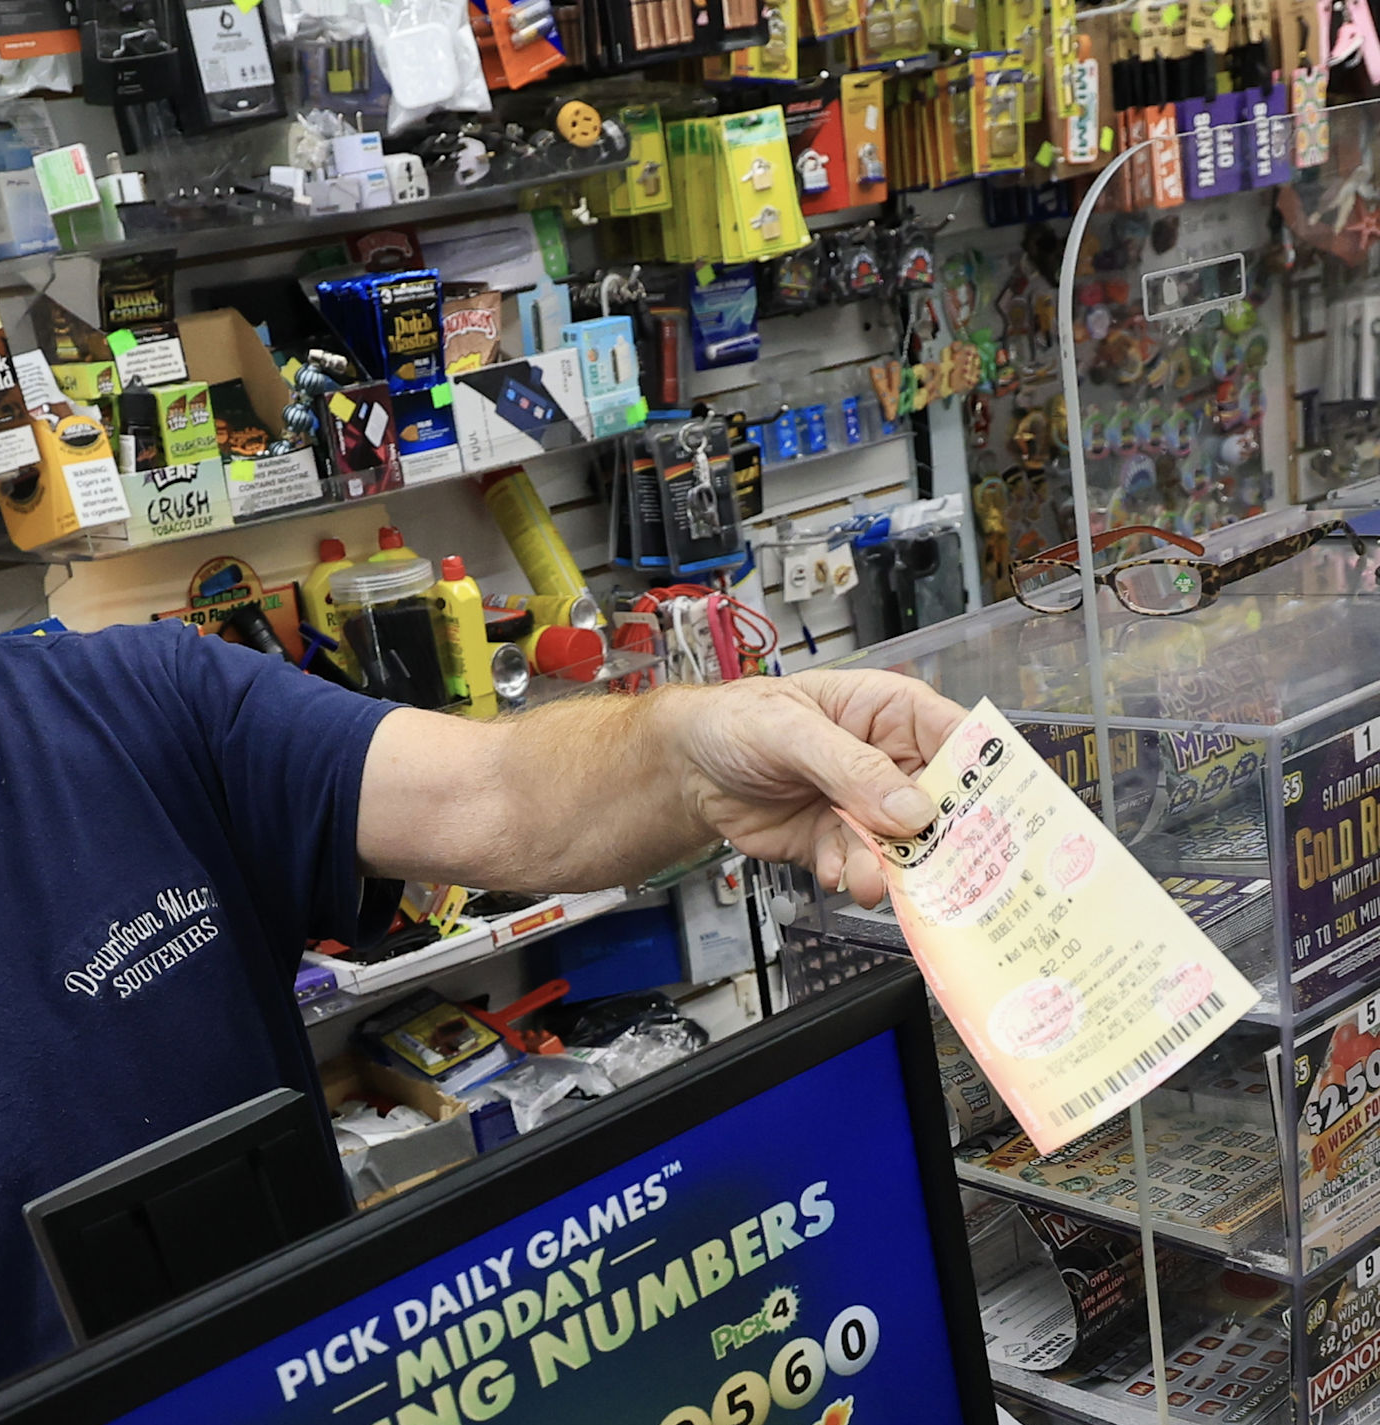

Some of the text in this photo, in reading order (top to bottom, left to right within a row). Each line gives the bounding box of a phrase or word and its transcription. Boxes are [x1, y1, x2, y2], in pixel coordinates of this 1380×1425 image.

[1194, 112, 1215, 188] HANDS
[1217, 119, 1234, 168] OFF
[1253, 103, 1270, 177] HANDS
[155, 464, 198, 489] LEAF
[148, 490, 210, 526] CRUSH
[152, 523, 193, 538] TOBACCO
[984, 841, 1020, 882] 40 63
[1295, 819, 1353, 891] GOLD
[112, 915, 219, 999] SOUVENIRS
[1039, 938, 1081, 978] $2.00
[1294, 937, 1311, 960] UP
[1315, 926, 1332, 948] TO
[1328, 1113, 1363, 1153] WEEK
[530, 1180, 836, 1388] NUMBERS
[277, 1316, 388, 1402] PICK
[394, 1247, 514, 1341] DAILY
[398, 1255, 607, 1398] MIDDAY
[784, 1349, 812, 1396] 6
[840, 1318, 866, 1361] 0
[1337, 1375, 1370, 1408] SECRET
